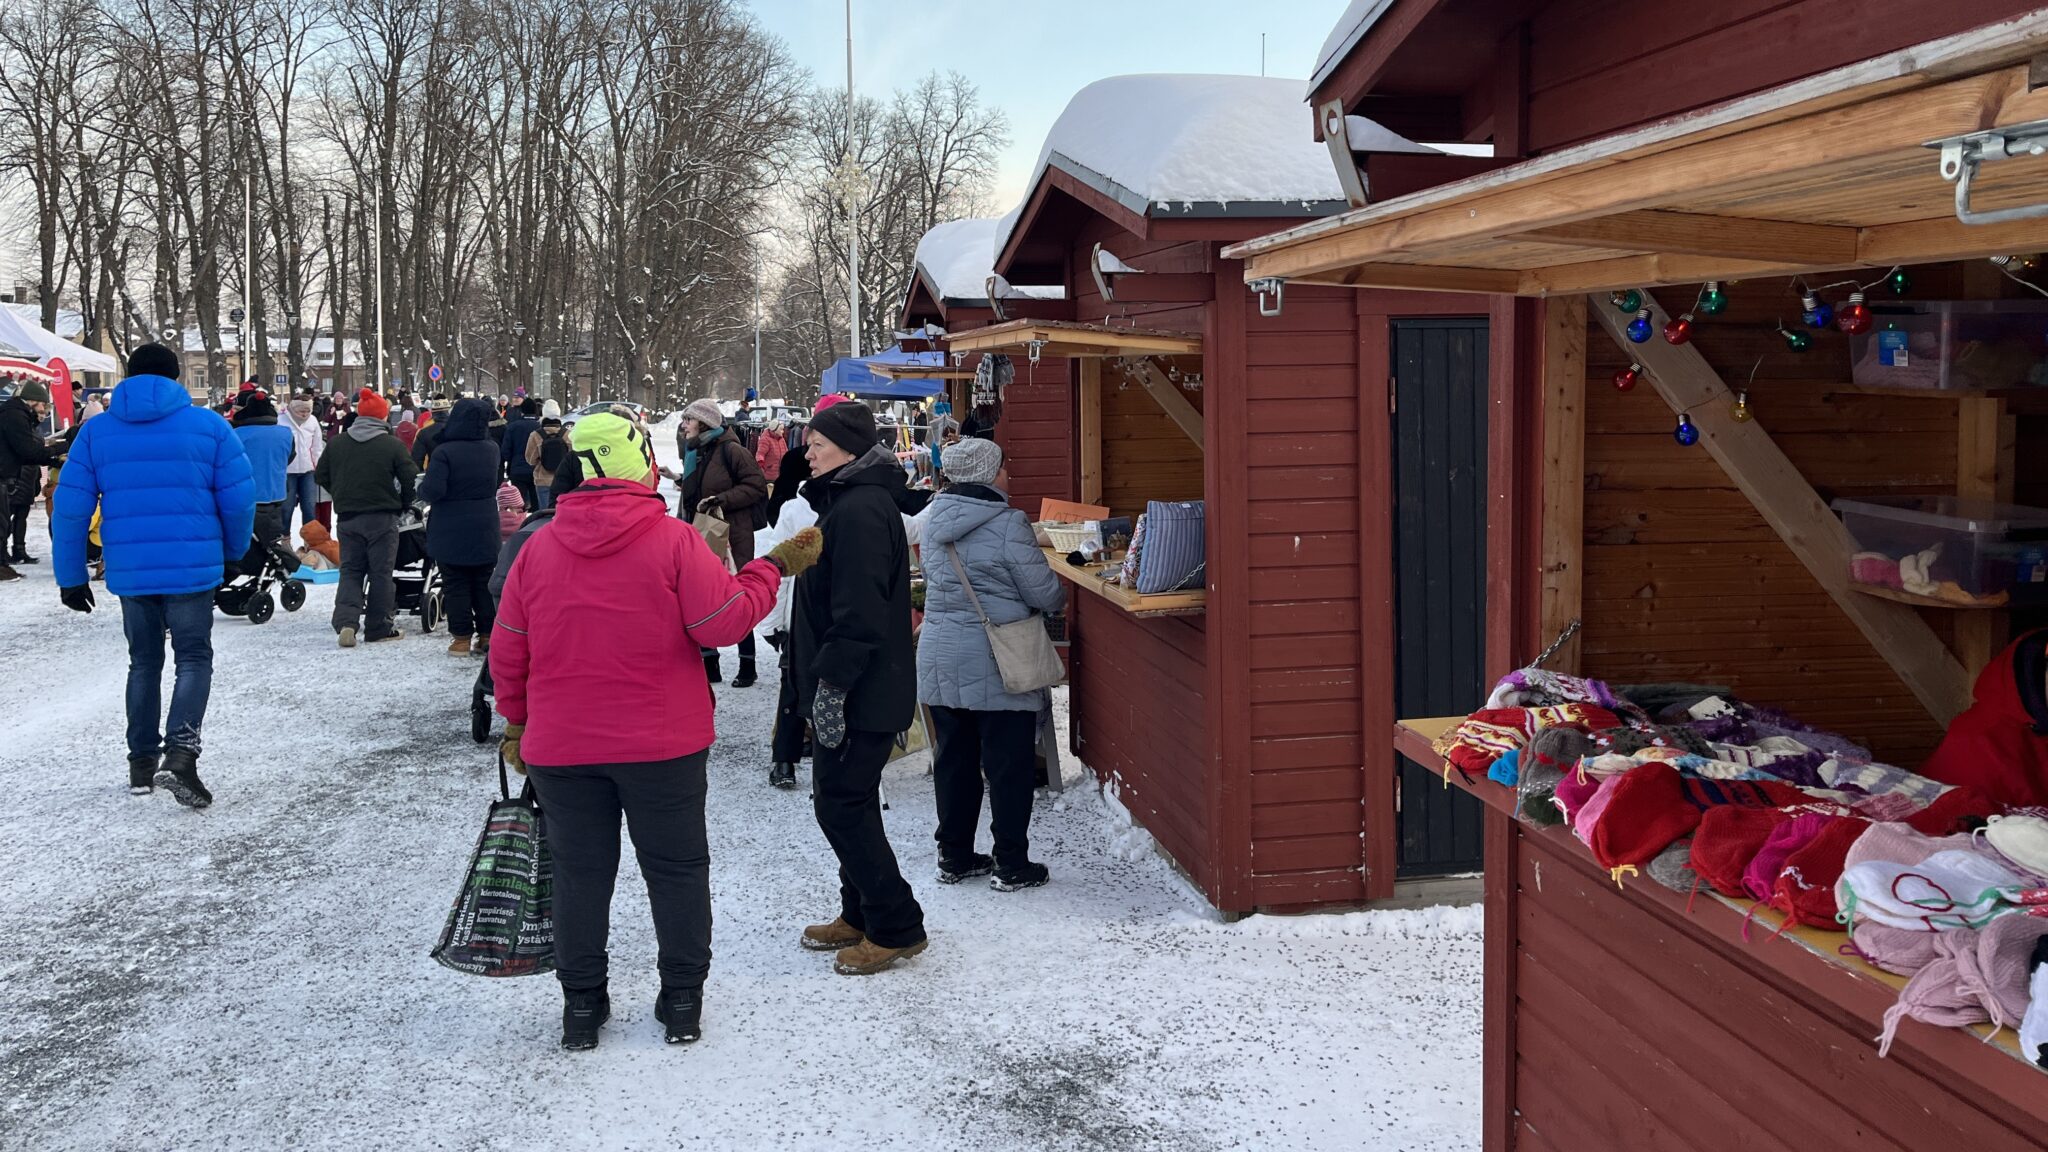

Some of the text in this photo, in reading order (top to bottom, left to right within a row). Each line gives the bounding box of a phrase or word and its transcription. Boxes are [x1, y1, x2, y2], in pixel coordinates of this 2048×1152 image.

[480, 888, 521, 900] kiertotalous
[478, 907, 517, 917] ympäristö-
[450, 890, 471, 947] ympäristö-
[476, 916, 507, 925] kasvatus
[460, 912, 475, 947] vastuu
